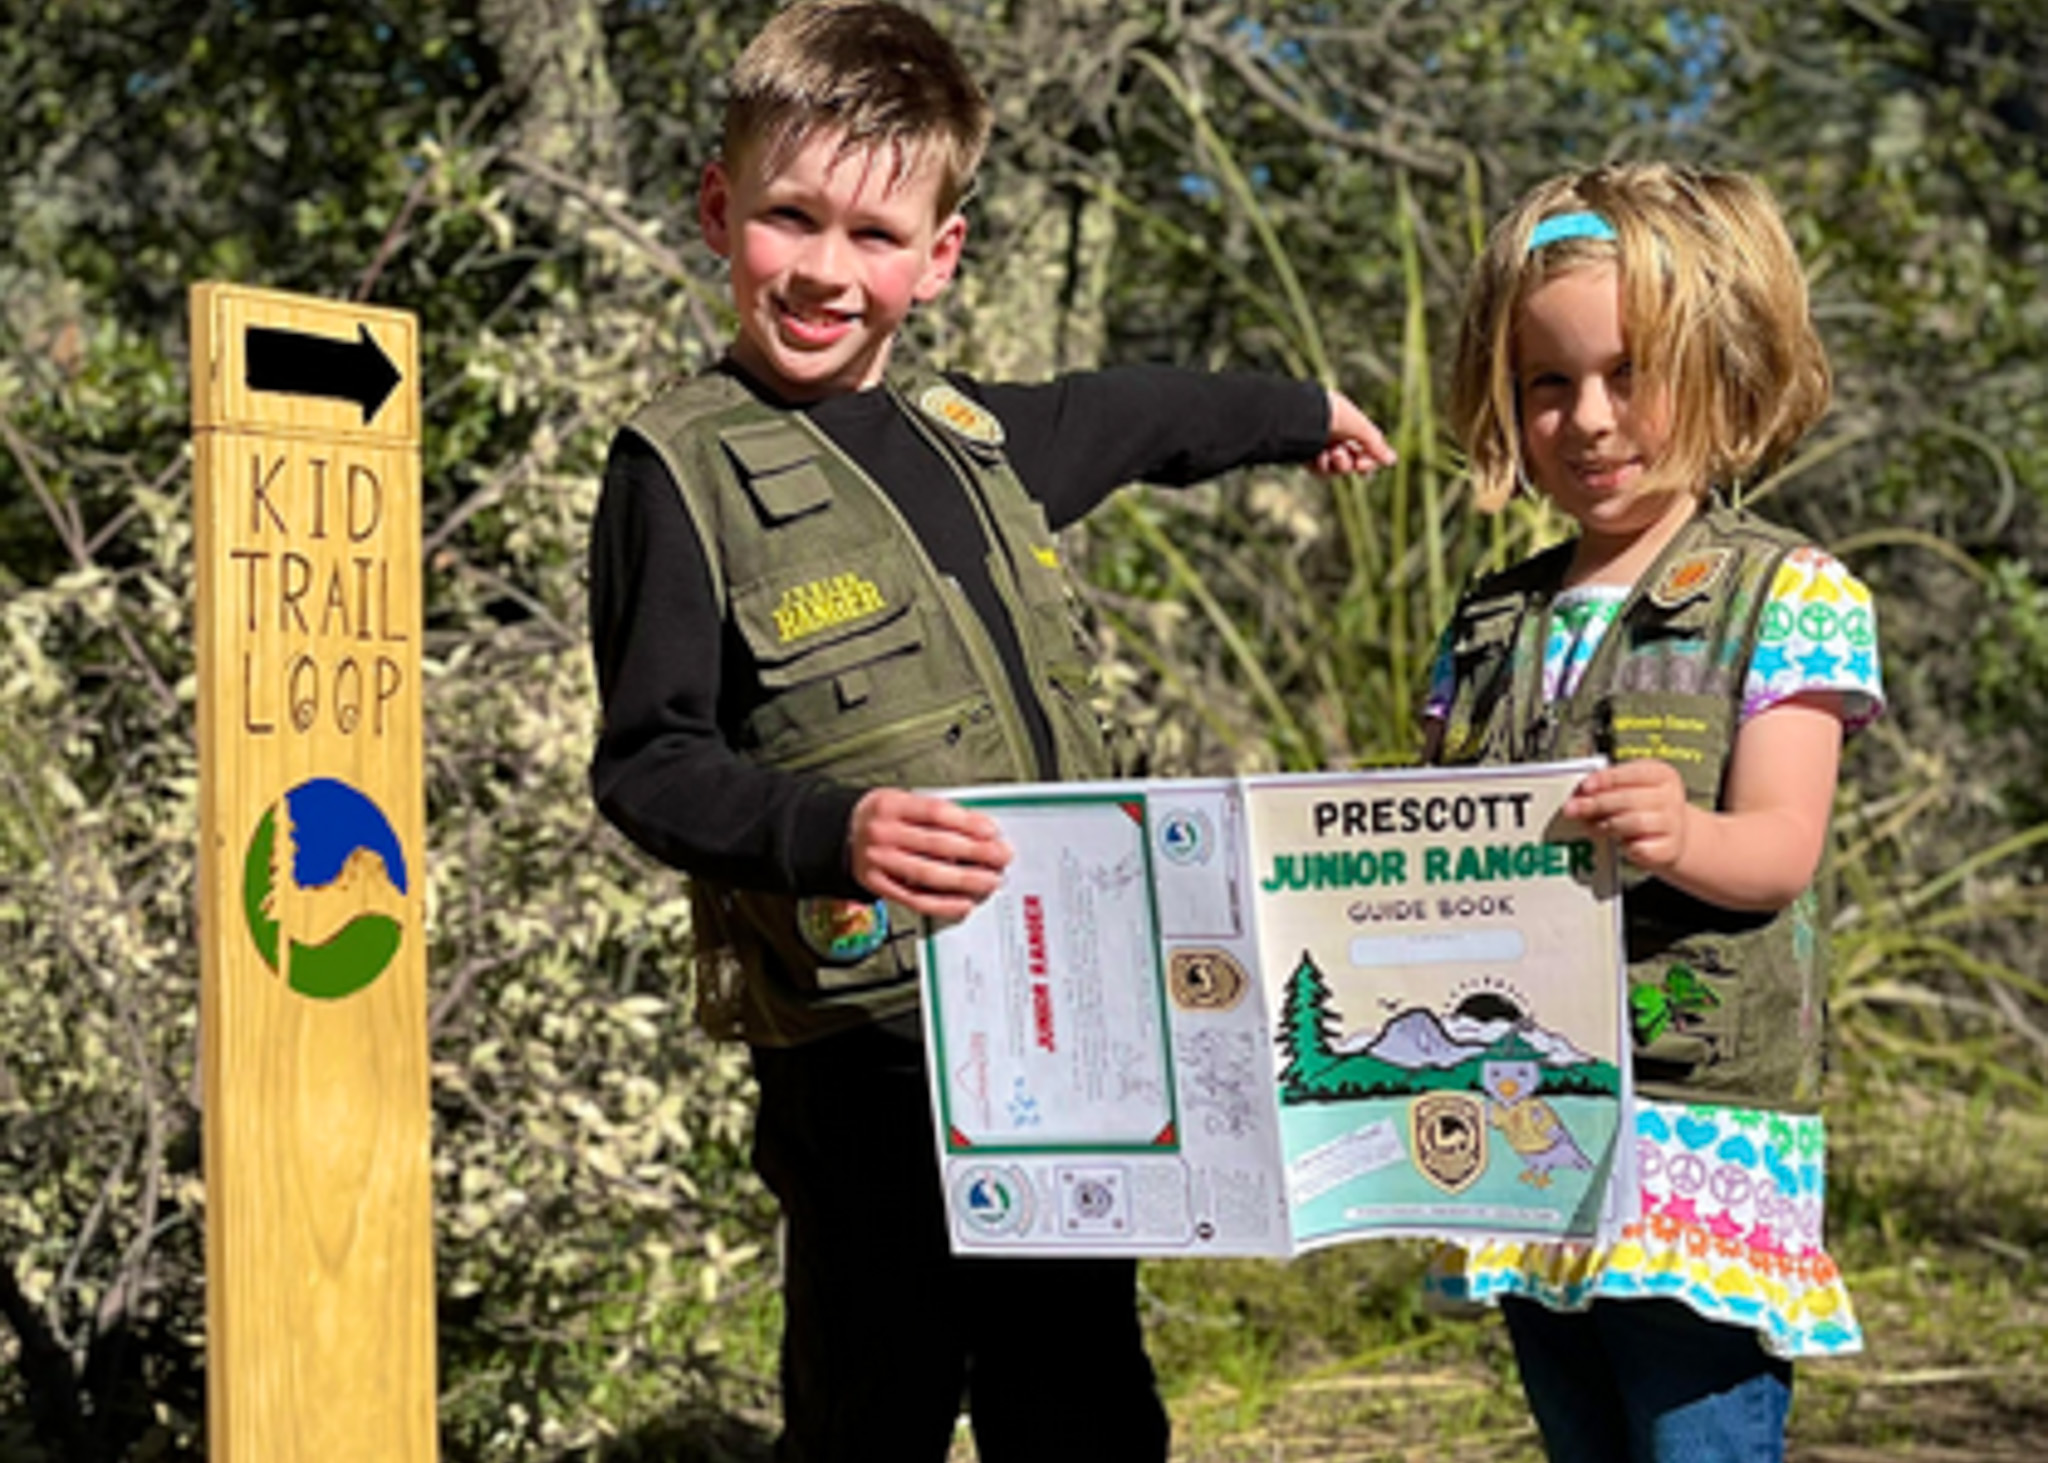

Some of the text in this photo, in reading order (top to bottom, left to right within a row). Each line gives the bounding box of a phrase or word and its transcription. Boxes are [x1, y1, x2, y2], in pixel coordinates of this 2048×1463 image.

[251, 454, 383, 543] KID
[230, 551, 408, 642] TRAIL
[774, 580, 885, 641] RANGER
[243, 651, 402, 737] LOOP
[1314, 793, 1532, 836] PRESCOTT
[1262, 839, 1595, 892] JUNIOR RANGER
[1023, 895, 1048, 976] RANGER
[1347, 895, 1516, 923] GUIDE BOOK
